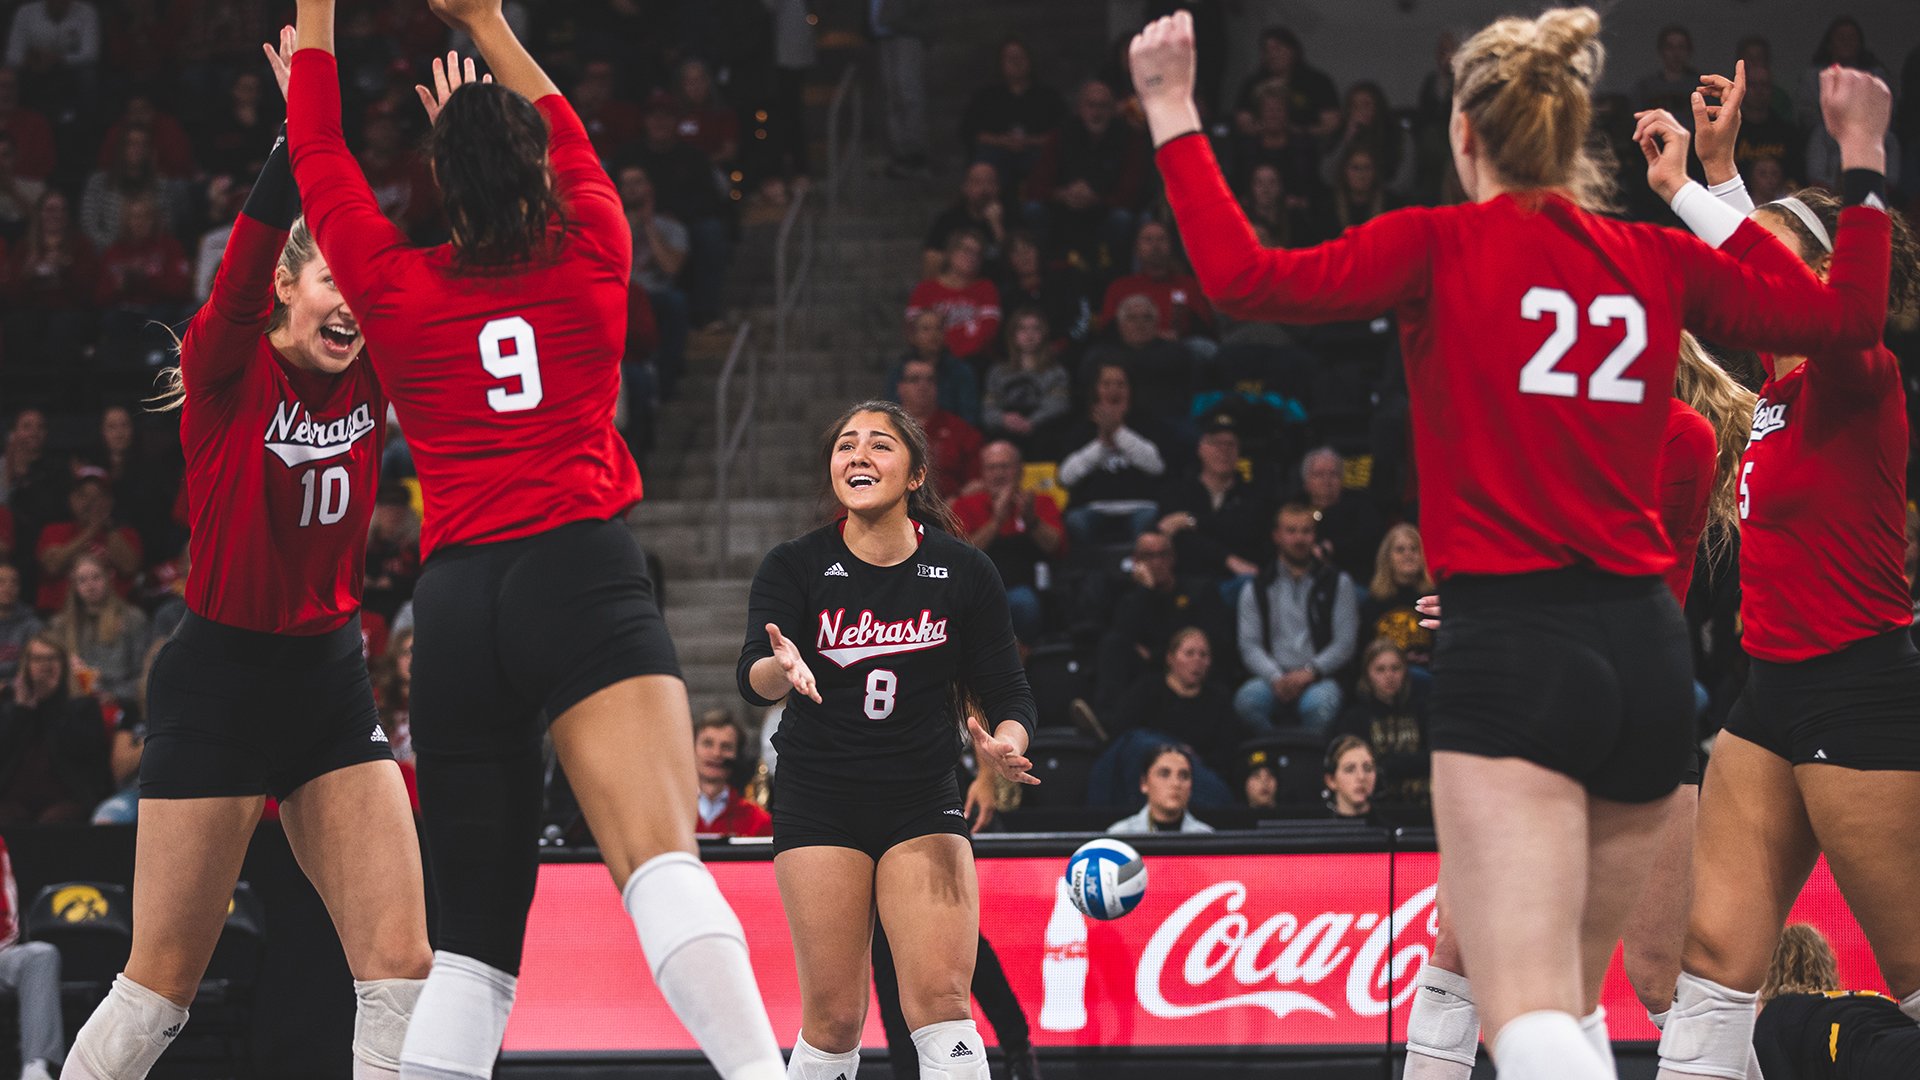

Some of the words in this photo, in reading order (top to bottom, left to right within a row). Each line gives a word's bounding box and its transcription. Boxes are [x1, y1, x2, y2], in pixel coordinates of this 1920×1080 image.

[478, 316, 543, 412] 9
[1519, 286, 1647, 403] 22
[300, 466, 350, 526] 10
[816, 608, 948, 652] Nebraska
[864, 667, 897, 721] 8
